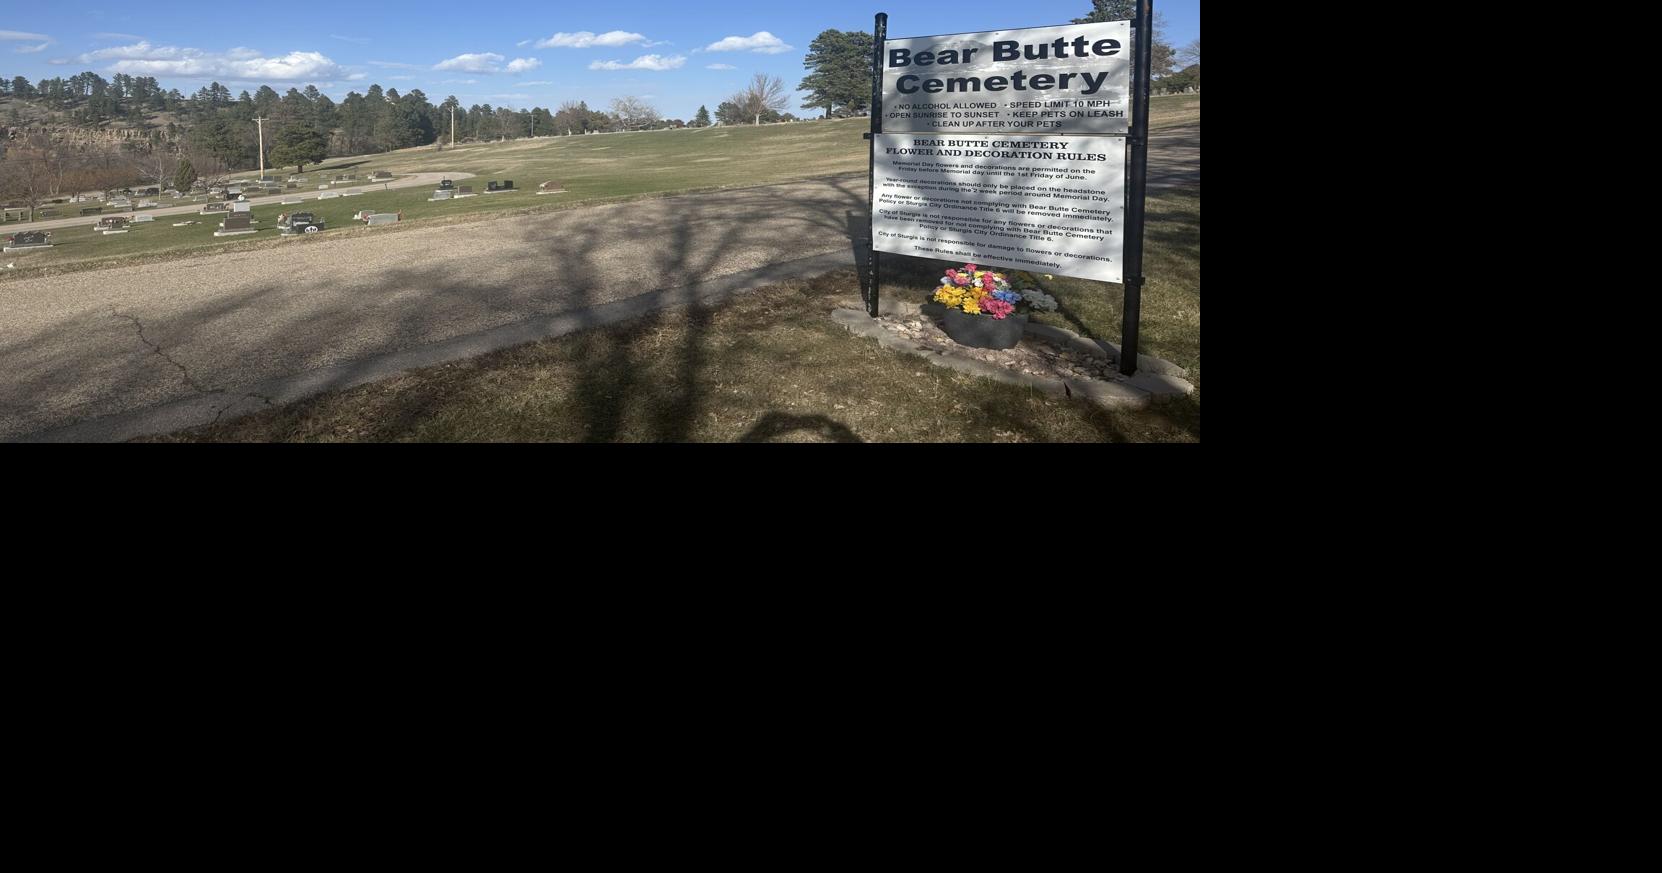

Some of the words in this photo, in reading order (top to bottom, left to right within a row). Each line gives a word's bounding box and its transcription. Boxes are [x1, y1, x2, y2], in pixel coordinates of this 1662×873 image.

[889, 48, 978, 67] Bear
[993, 35, 1121, 61] Butte
[896, 70, 1109, 95] Cemetery
[992, 141, 1068, 149] CEMETERY
[965, 150, 1052, 159] DECORATION
[1057, 153, 1106, 161] RULES
[973, 200, 1010, 208] complying
[1072, 208, 1110, 216] Cemetery
[1063, 214, 1113, 222] immediately.
[968, 223, 1004, 231] complying
[1066, 232, 1104, 241] Cemetery
[1047, 224, 1094, 233] decorations
[938, 238, 974, 246] responsible
[1064, 252, 1112, 262] decorations.
[1015, 257, 1061, 268] immediately.
